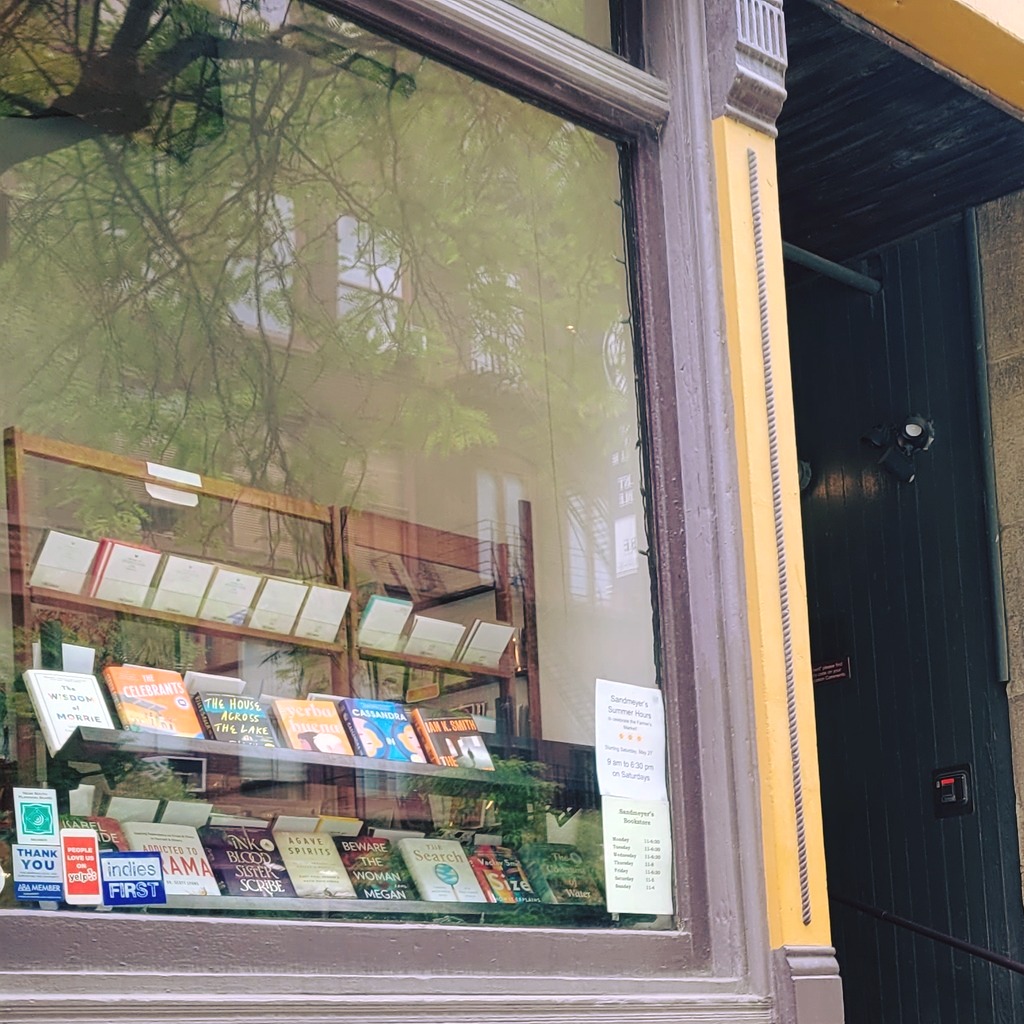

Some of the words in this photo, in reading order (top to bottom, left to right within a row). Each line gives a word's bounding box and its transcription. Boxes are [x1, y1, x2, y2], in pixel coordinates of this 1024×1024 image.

[142, 674, 155, 682] THE
[123, 682, 185, 697] CELEBRANTS
[48, 693, 95, 702] WISDOM
[610, 694, 649, 708] Sandmeyer's
[204, 697, 225, 709] THE
[230, 698, 262, 712] HOUSE
[286, 703, 333, 718] yerba
[56, 713, 102, 723] MORRIE
[221, 711, 260, 723] ACROSS
[352, 708, 408, 721] CASSANDRA
[608, 705, 634, 716] Summer
[635, 710, 652, 720] Hours
[214, 723, 238, 735] THE
[240, 724, 269, 735] LAKE
[289, 719, 341, 733] buena
[425, 720, 442, 733] IAN
[441, 720, 452, 732] K.
[450, 720, 477, 732] SMITH
[440, 756, 459, 768] THE
[644, 764, 655, 772] pm
[621, 771, 651, 783] Saturdays
[619, 808, 655, 818] Sandmeyer's
[623, 817, 652, 826] Bookstore
[289, 837, 324, 846] AGAVE
[341, 841, 389, 853] BEWARE
[17, 849, 58, 858] THANK
[143, 844, 184, 855] ADDICTED
[186, 847, 198, 856] TO
[288, 847, 331, 856] SPIRITS
[226, 850, 272, 865] BLOOD
[360, 857, 384, 867] THE
[413, 850, 464, 863] Search
[22, 860, 55, 871] YOU
[107, 862, 157, 877] indies
[69, 873, 88, 883] yelp
[235, 865, 280, 880] SISTER
[353, 871, 402, 882] WOMAN
[32, 884, 61, 892] MEMBER
[240, 879, 286, 897] SCRIBE
[487, 873, 535, 894] Size
[108, 882, 160, 899] FIRST
[364, 889, 407, 900] MEGAN
